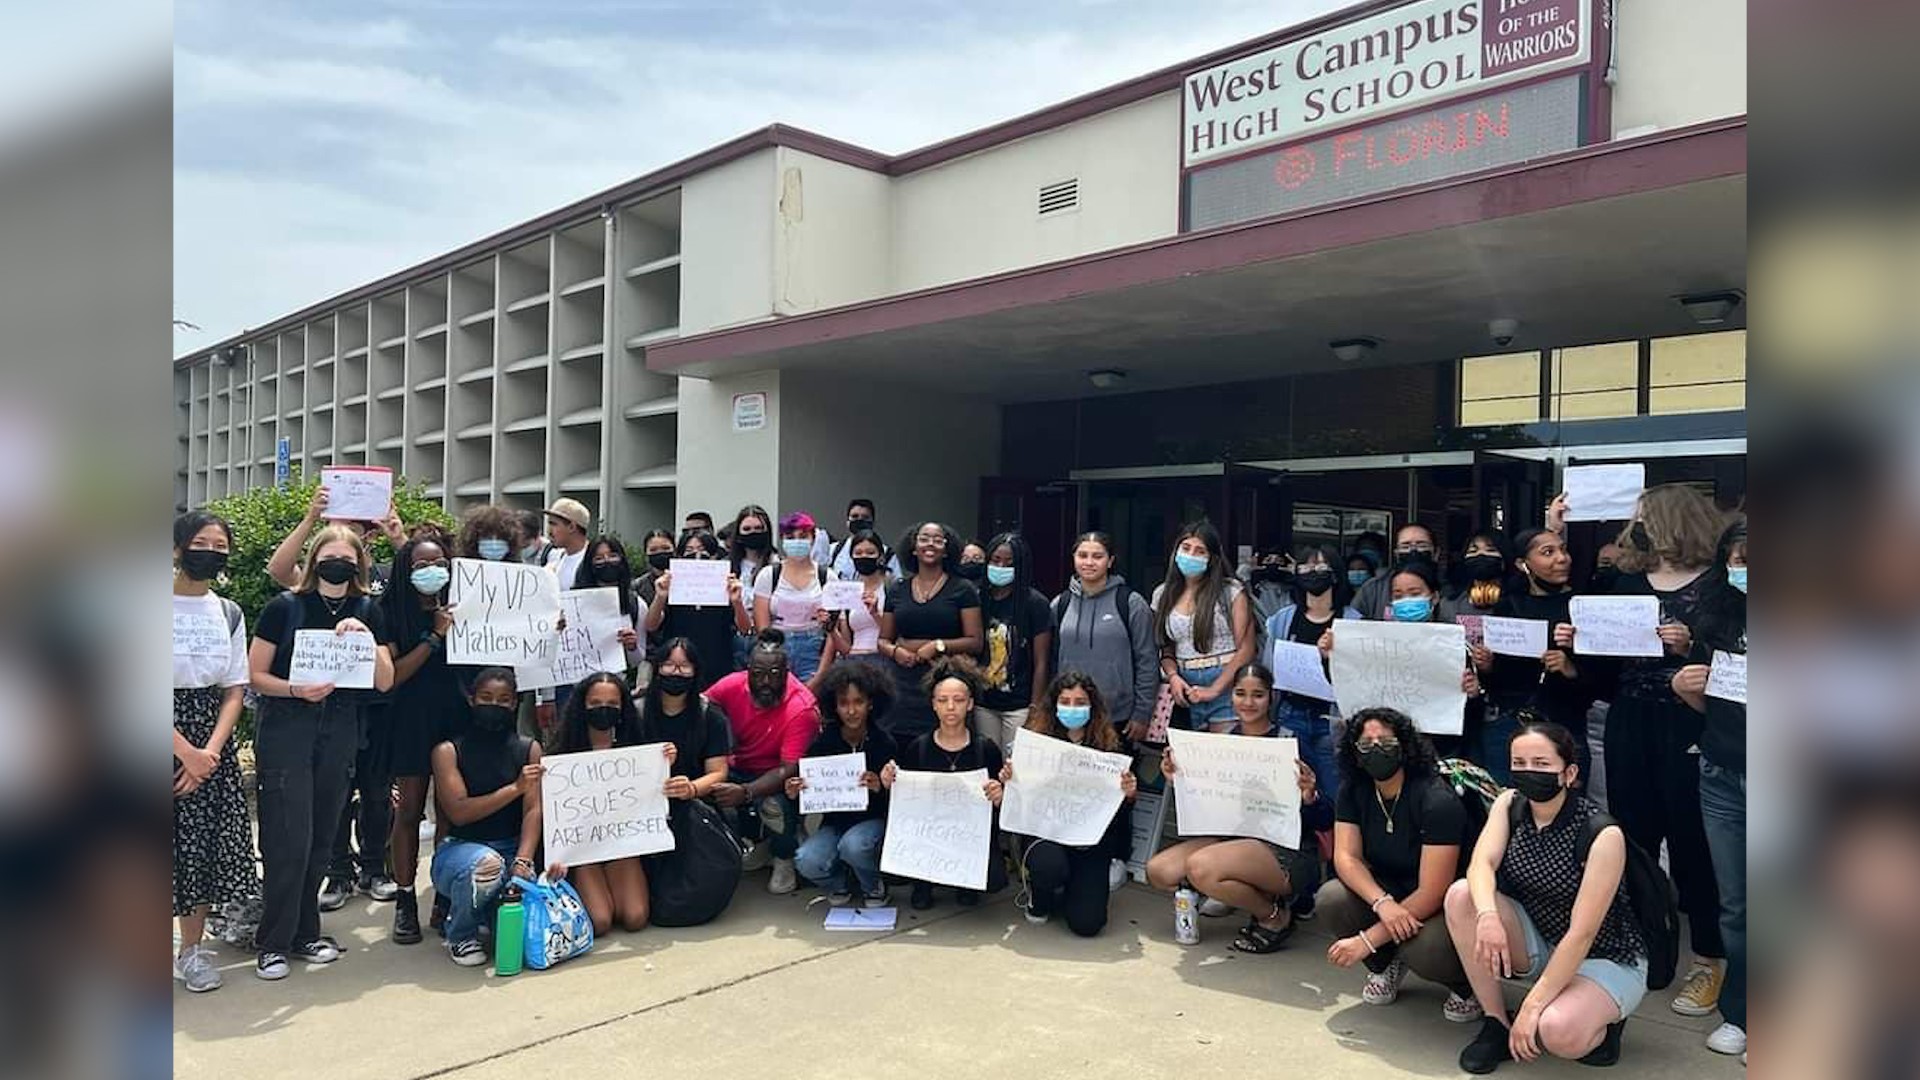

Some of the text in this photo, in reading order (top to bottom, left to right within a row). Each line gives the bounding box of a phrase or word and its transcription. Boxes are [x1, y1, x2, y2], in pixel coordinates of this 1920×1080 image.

[1498, 17, 1523, 36] OF
[1527, 6, 1560, 28] THE
[1190, 3, 1479, 113] West Campus
[1484, 19, 1576, 68] WARRIORS
[1332, 100, 1512, 178] FLORIN
[457, 560, 498, 624] My
[504, 569, 539, 611] VP
[450, 618, 518, 655] Matters
[547, 757, 647, 796] SCHOOL
[553, 786, 639, 823] ISSUES
[551, 816, 667, 848] ARE ADRESSED
